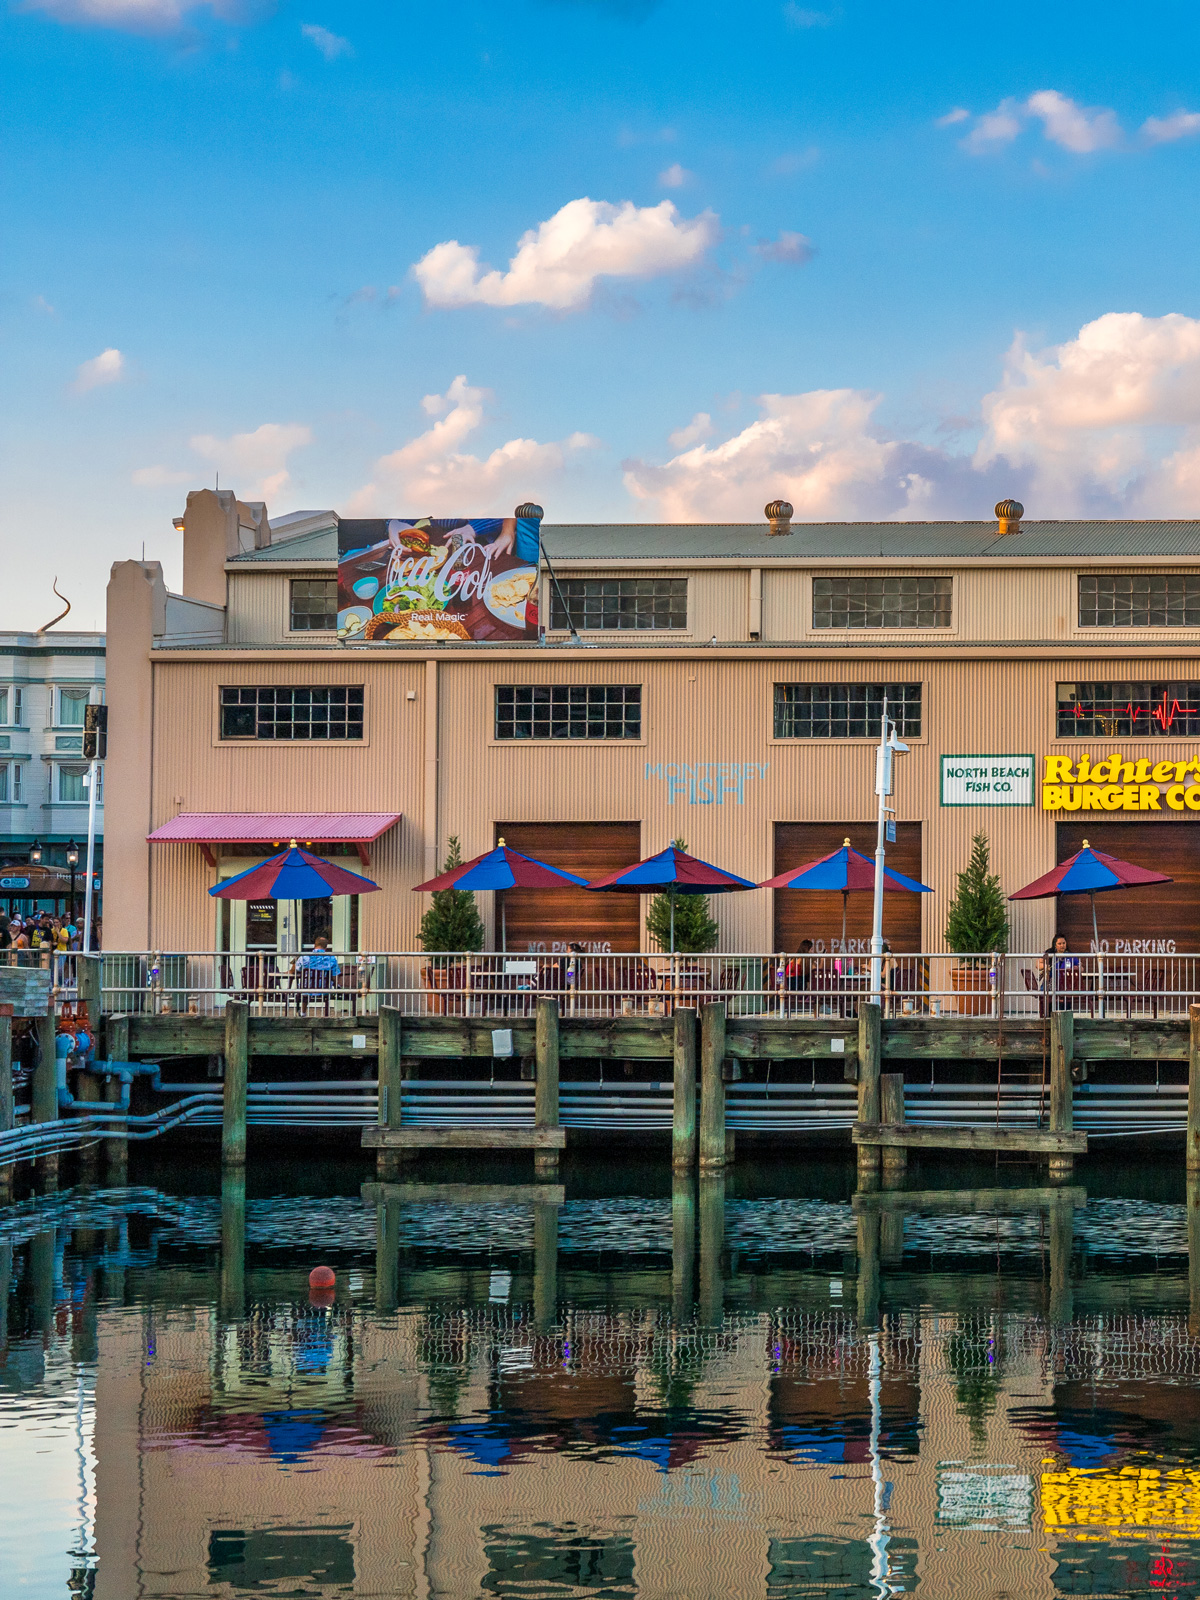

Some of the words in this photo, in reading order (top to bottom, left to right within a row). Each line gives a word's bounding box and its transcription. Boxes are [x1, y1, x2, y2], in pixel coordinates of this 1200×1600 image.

[411, 613, 433, 621] Real
[645, 762, 770, 780] MONTEREY
[947, 767, 988, 779] NORTH
[991, 767, 1030, 778] BEACH
[666, 775, 745, 805] FISH
[965, 781, 991, 793] FISH
[993, 781, 1013, 792] CO.
[1042, 784, 1162, 811] BURGER
[527, 941, 547, 953] NO
[1089, 939, 1110, 954] NO
[1115, 939, 1177, 954] PARKING
